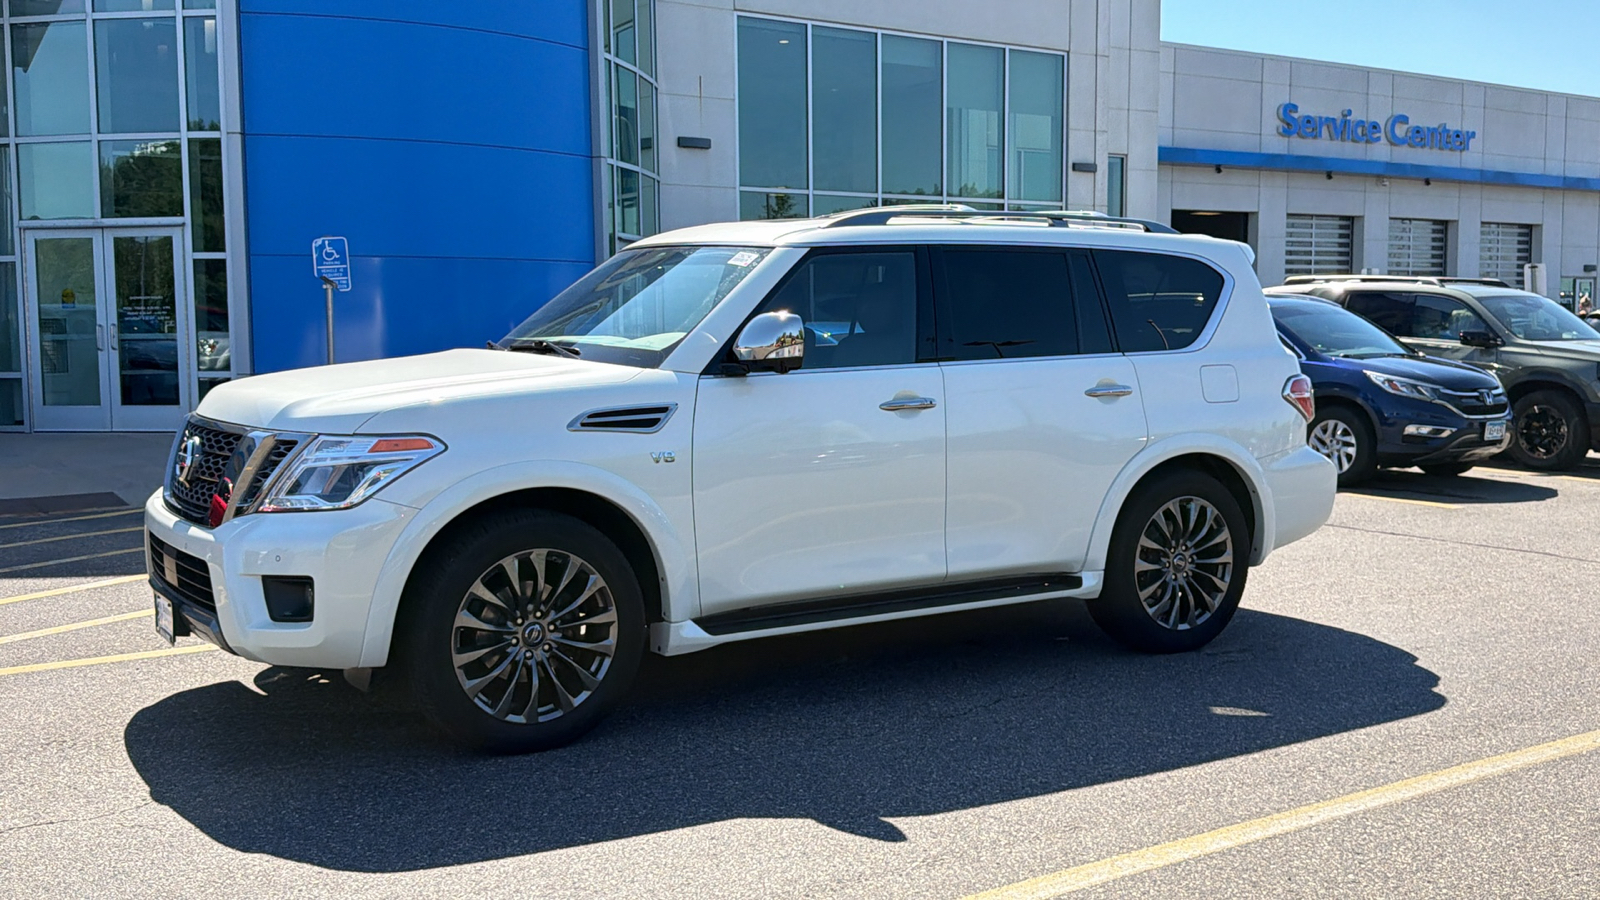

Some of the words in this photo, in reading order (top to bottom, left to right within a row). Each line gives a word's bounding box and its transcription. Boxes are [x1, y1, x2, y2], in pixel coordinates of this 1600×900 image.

[1277, 102, 1382, 143] Service
[1385, 114, 1476, 151] Center
[650, 451, 676, 464] V8
